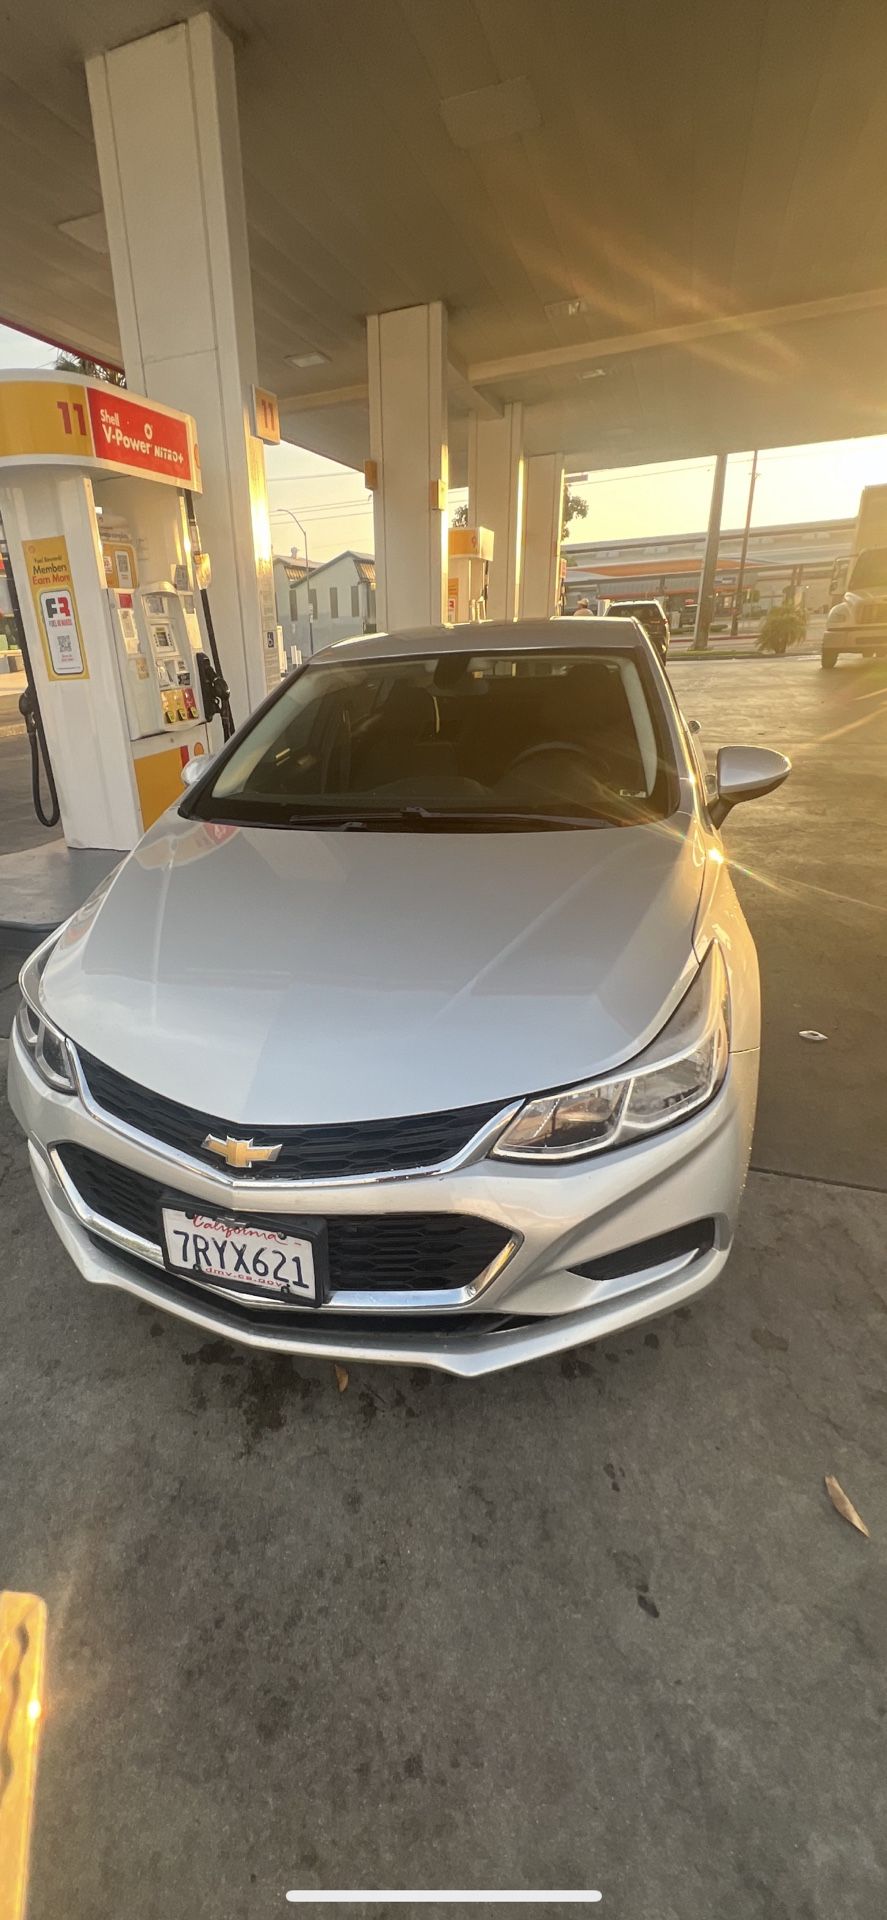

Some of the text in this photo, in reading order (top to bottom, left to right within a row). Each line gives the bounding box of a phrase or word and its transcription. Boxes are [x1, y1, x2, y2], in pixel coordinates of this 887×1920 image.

[57, 401, 87, 436] 11
[100, 409, 120, 427] Shell
[261, 399, 275, 431] 11
[103, 426, 152, 455] V-Power
[33, 563, 67, 575] Members
[33, 574, 70, 585] Earn More
[193, 1214, 288, 1246] California
[173, 1230, 309, 1289] 7RYX621
[205, 1267, 283, 1287] dmv.ca.gov
